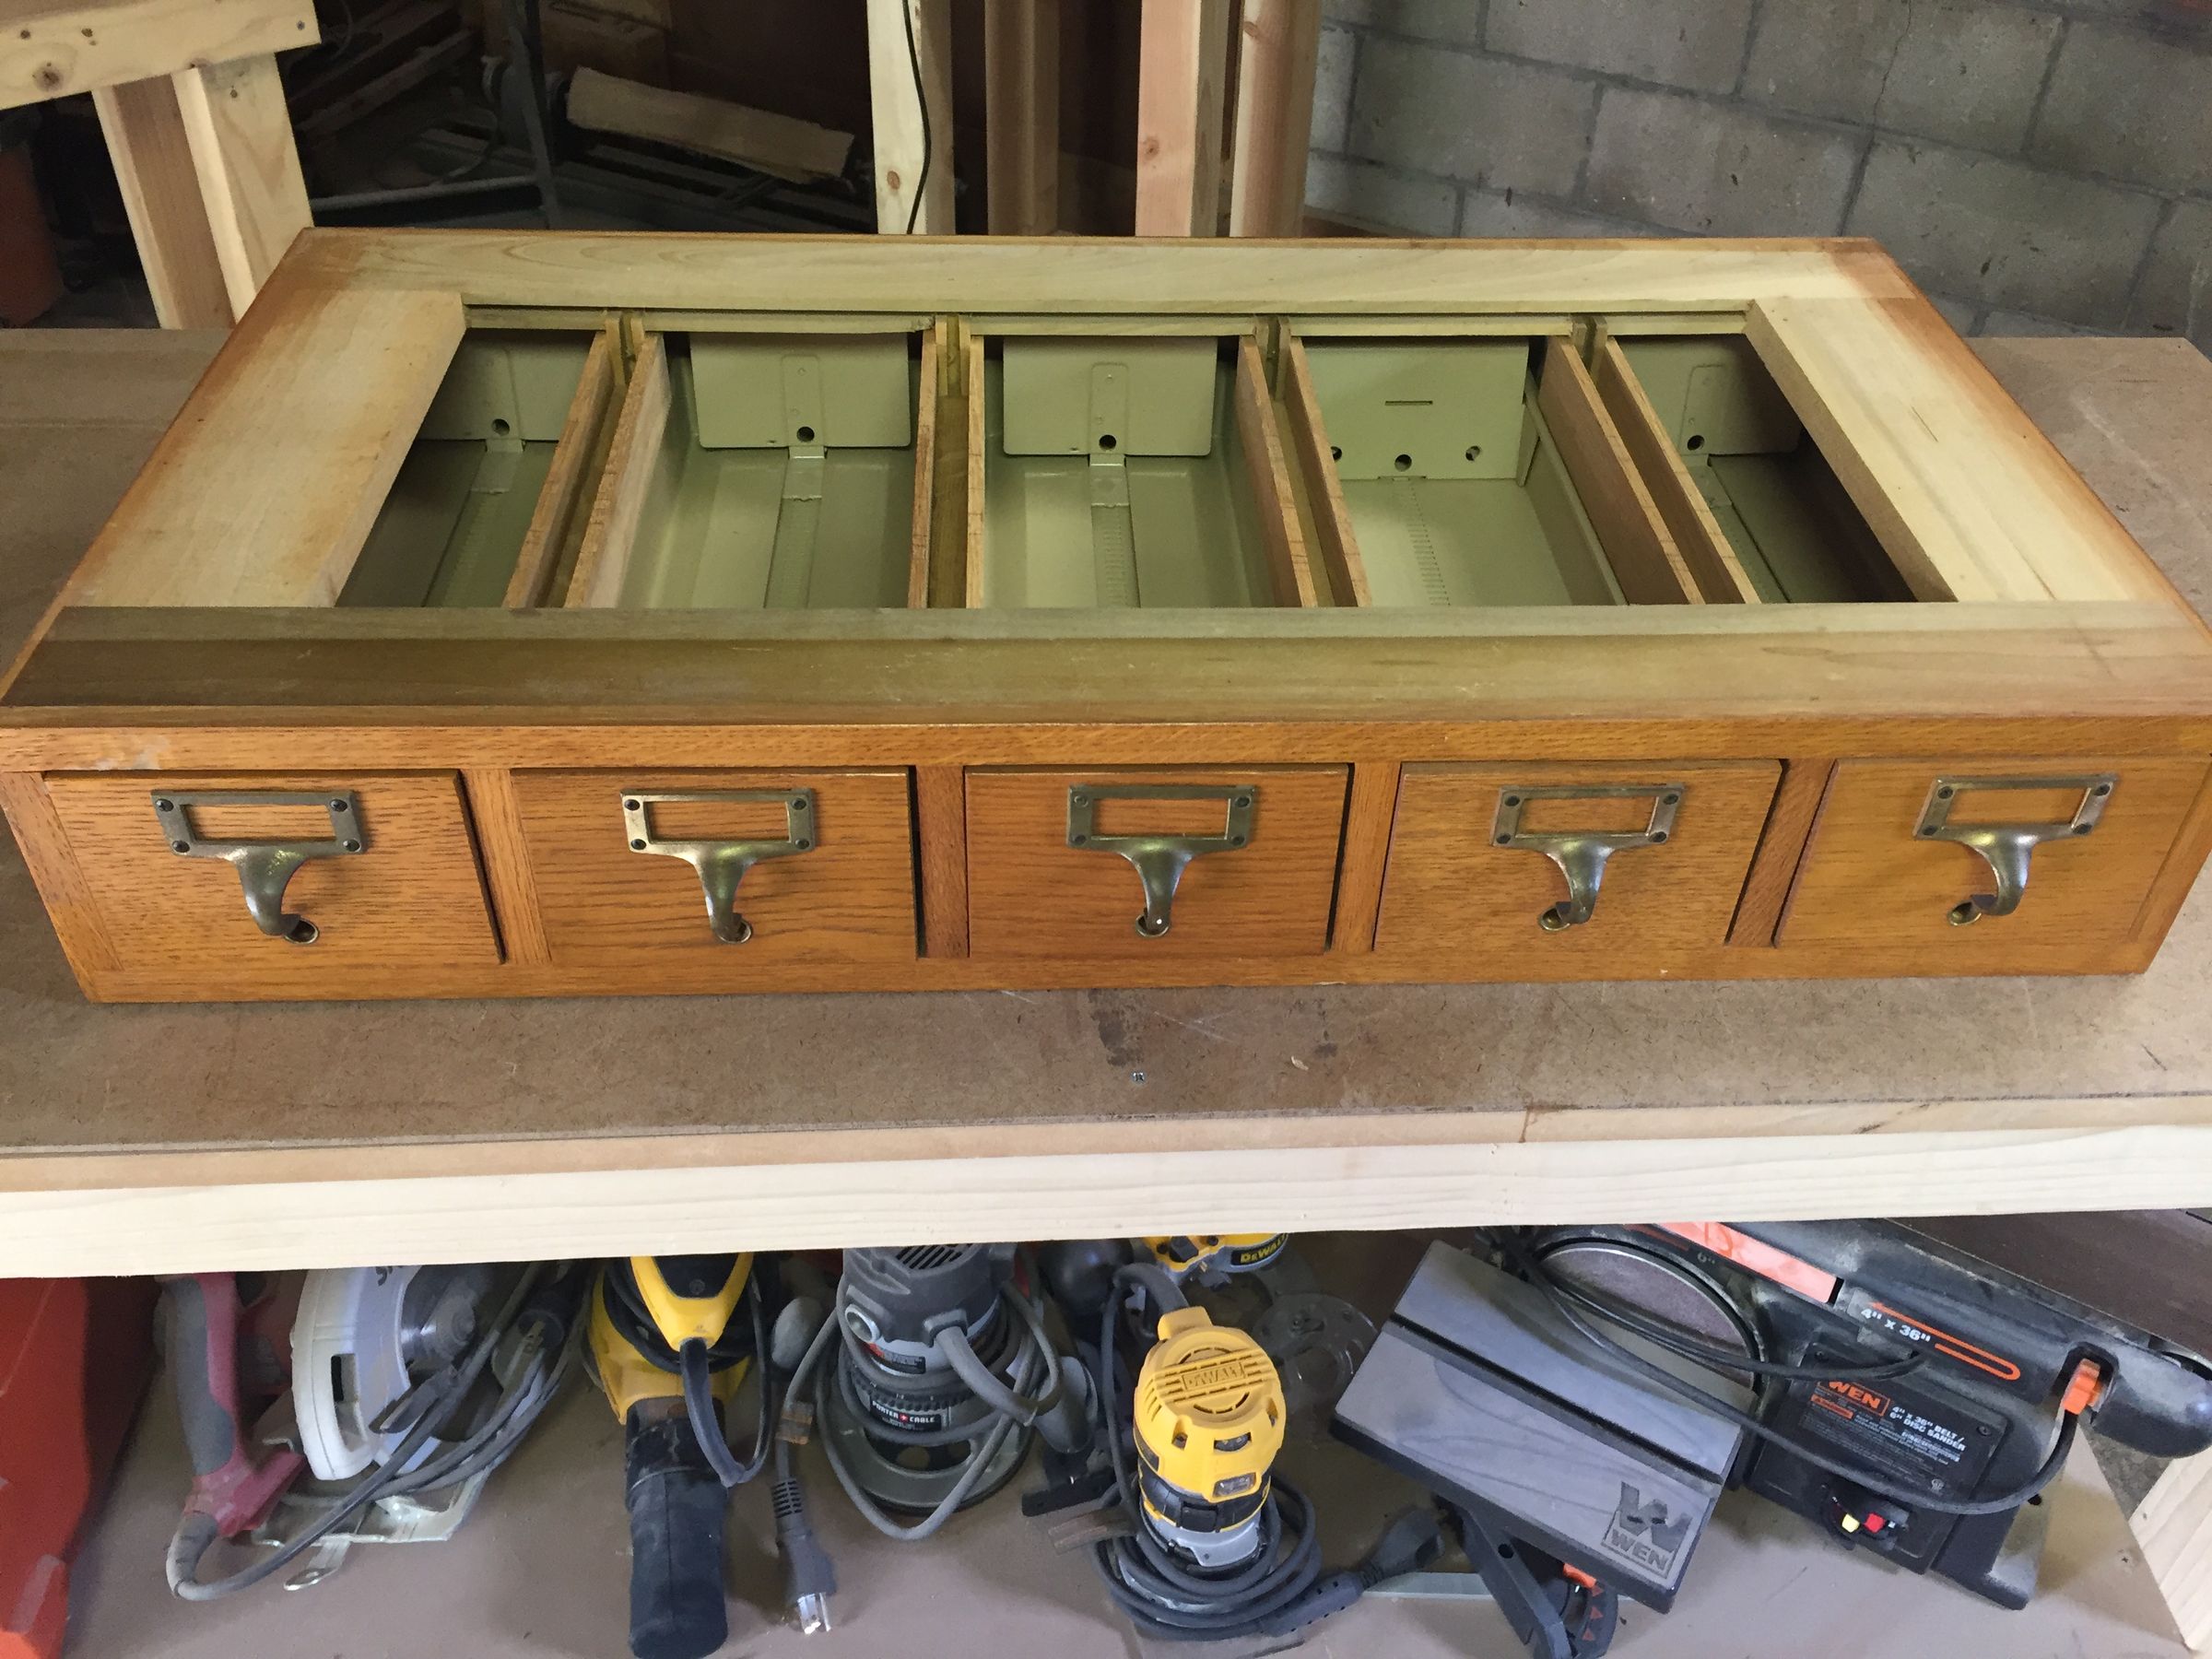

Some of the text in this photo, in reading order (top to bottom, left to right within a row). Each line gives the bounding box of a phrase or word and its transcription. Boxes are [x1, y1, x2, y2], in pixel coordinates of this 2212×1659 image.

[1861, 1309, 1882, 1320] 4"
[1900, 1324, 1931, 1342] 36"
[1829, 1381, 1881, 1409] WEN
[872, 1400, 899, 1419] PORTER
[909, 1416, 935, 1424] CABLE
[1903, 1418, 1926, 1433] DISC
[1926, 1429, 1967, 1452] SANDER
[1935, 1425, 1959, 1440] BELT
[1610, 1528, 1670, 1571] WEN
